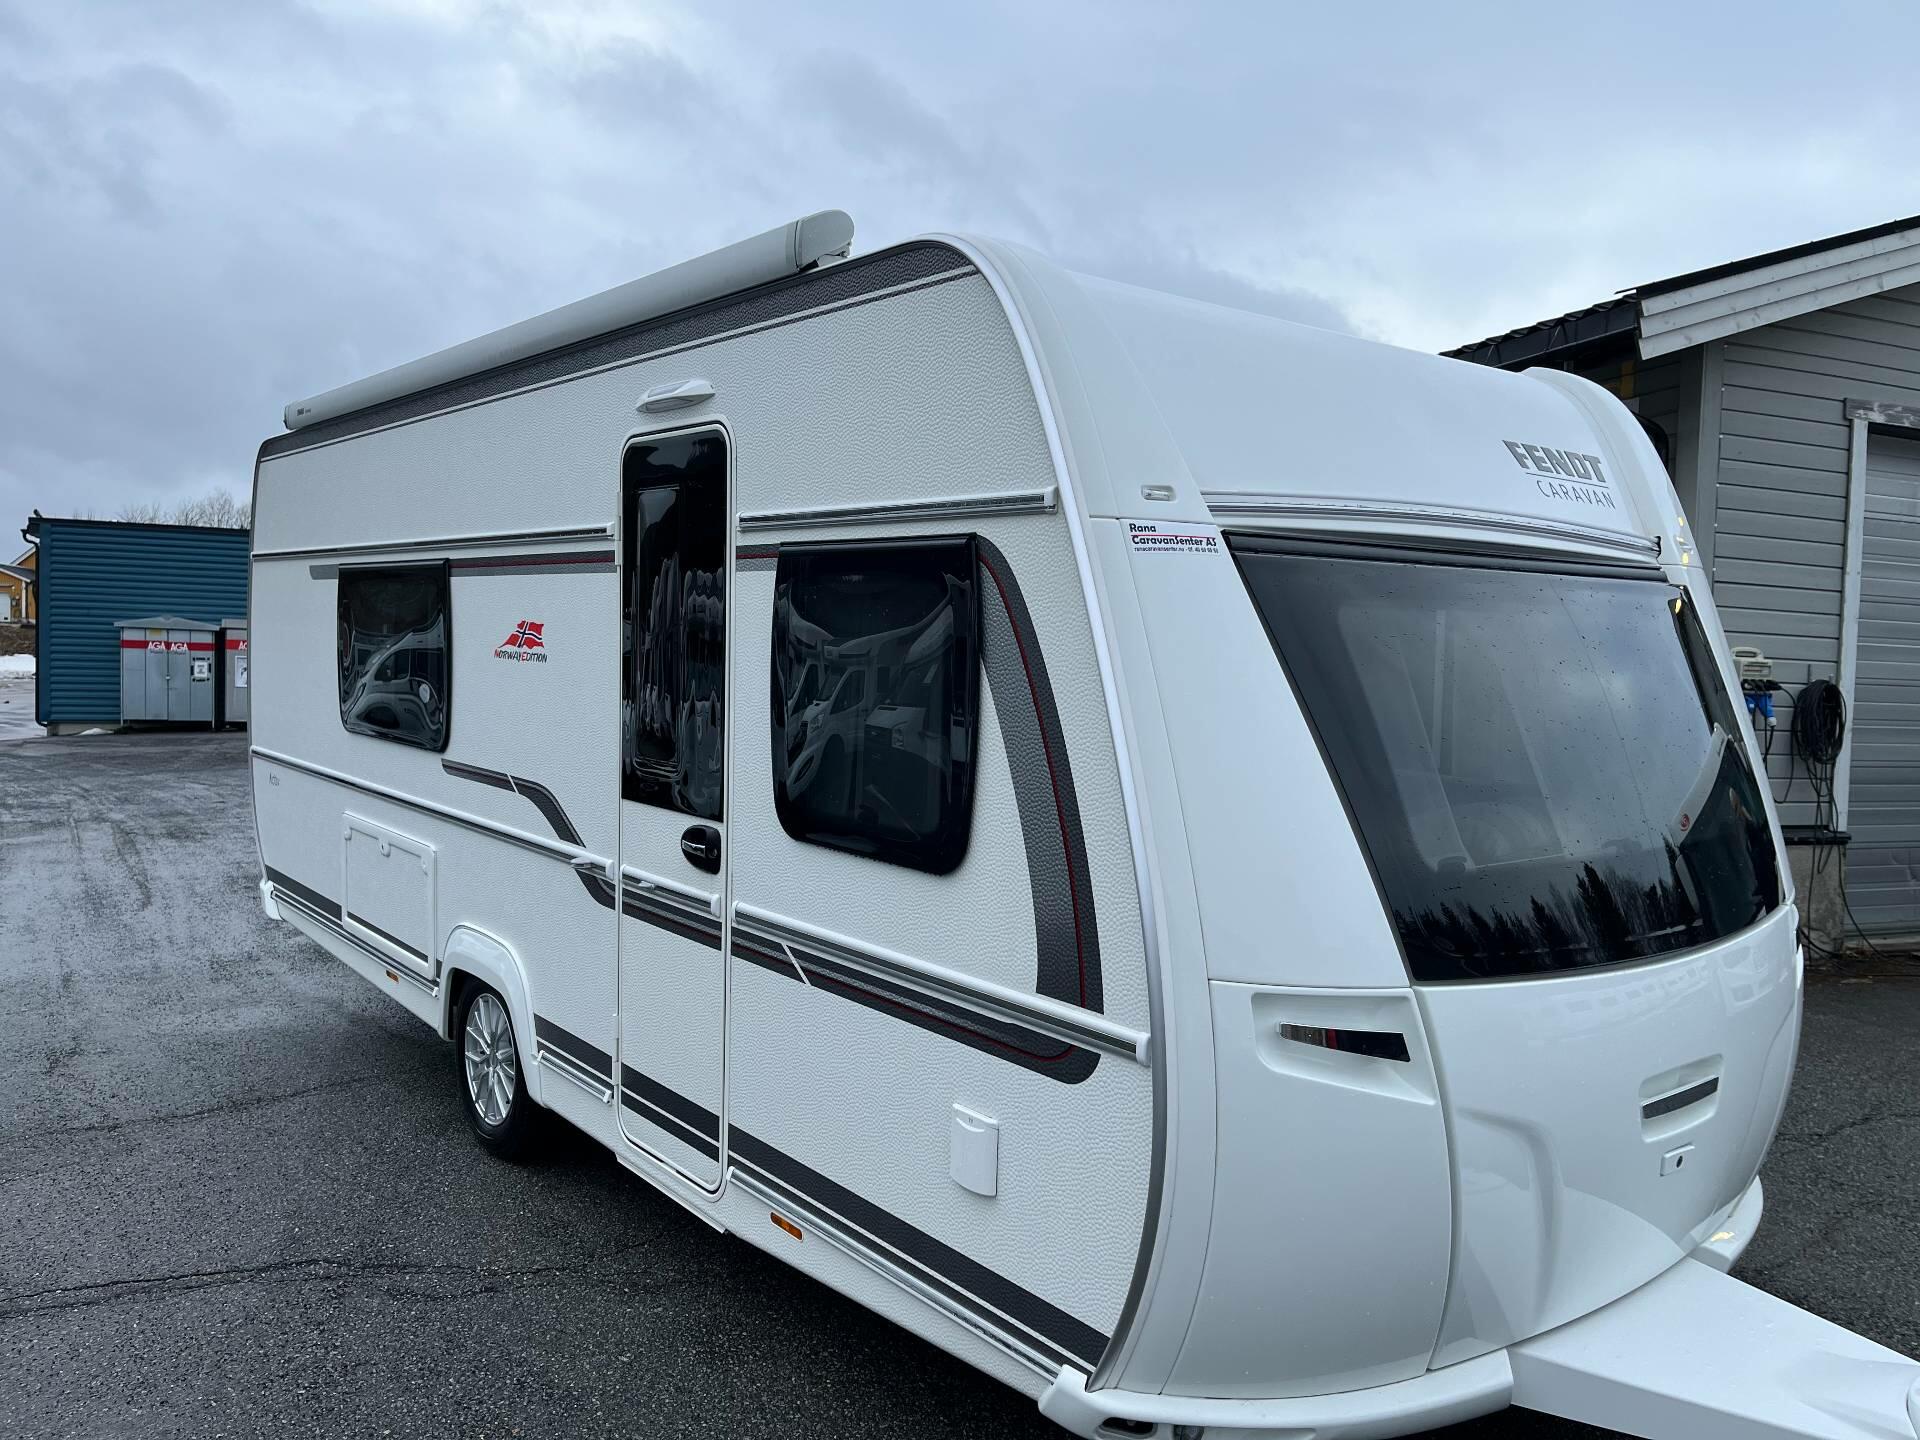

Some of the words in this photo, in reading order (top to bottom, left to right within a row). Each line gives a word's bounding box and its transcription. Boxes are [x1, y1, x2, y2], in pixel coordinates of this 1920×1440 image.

[1502, 439, 1606, 483] FENDT
[1536, 480, 1616, 509] CARAVAN
[1129, 523, 1157, 533] Rana
[1132, 535, 1203, 546] CaravanSenter
[1206, 538, 1217, 547] AS
[147, 641, 166, 651] AGA
[170, 642, 189, 652] AGA
